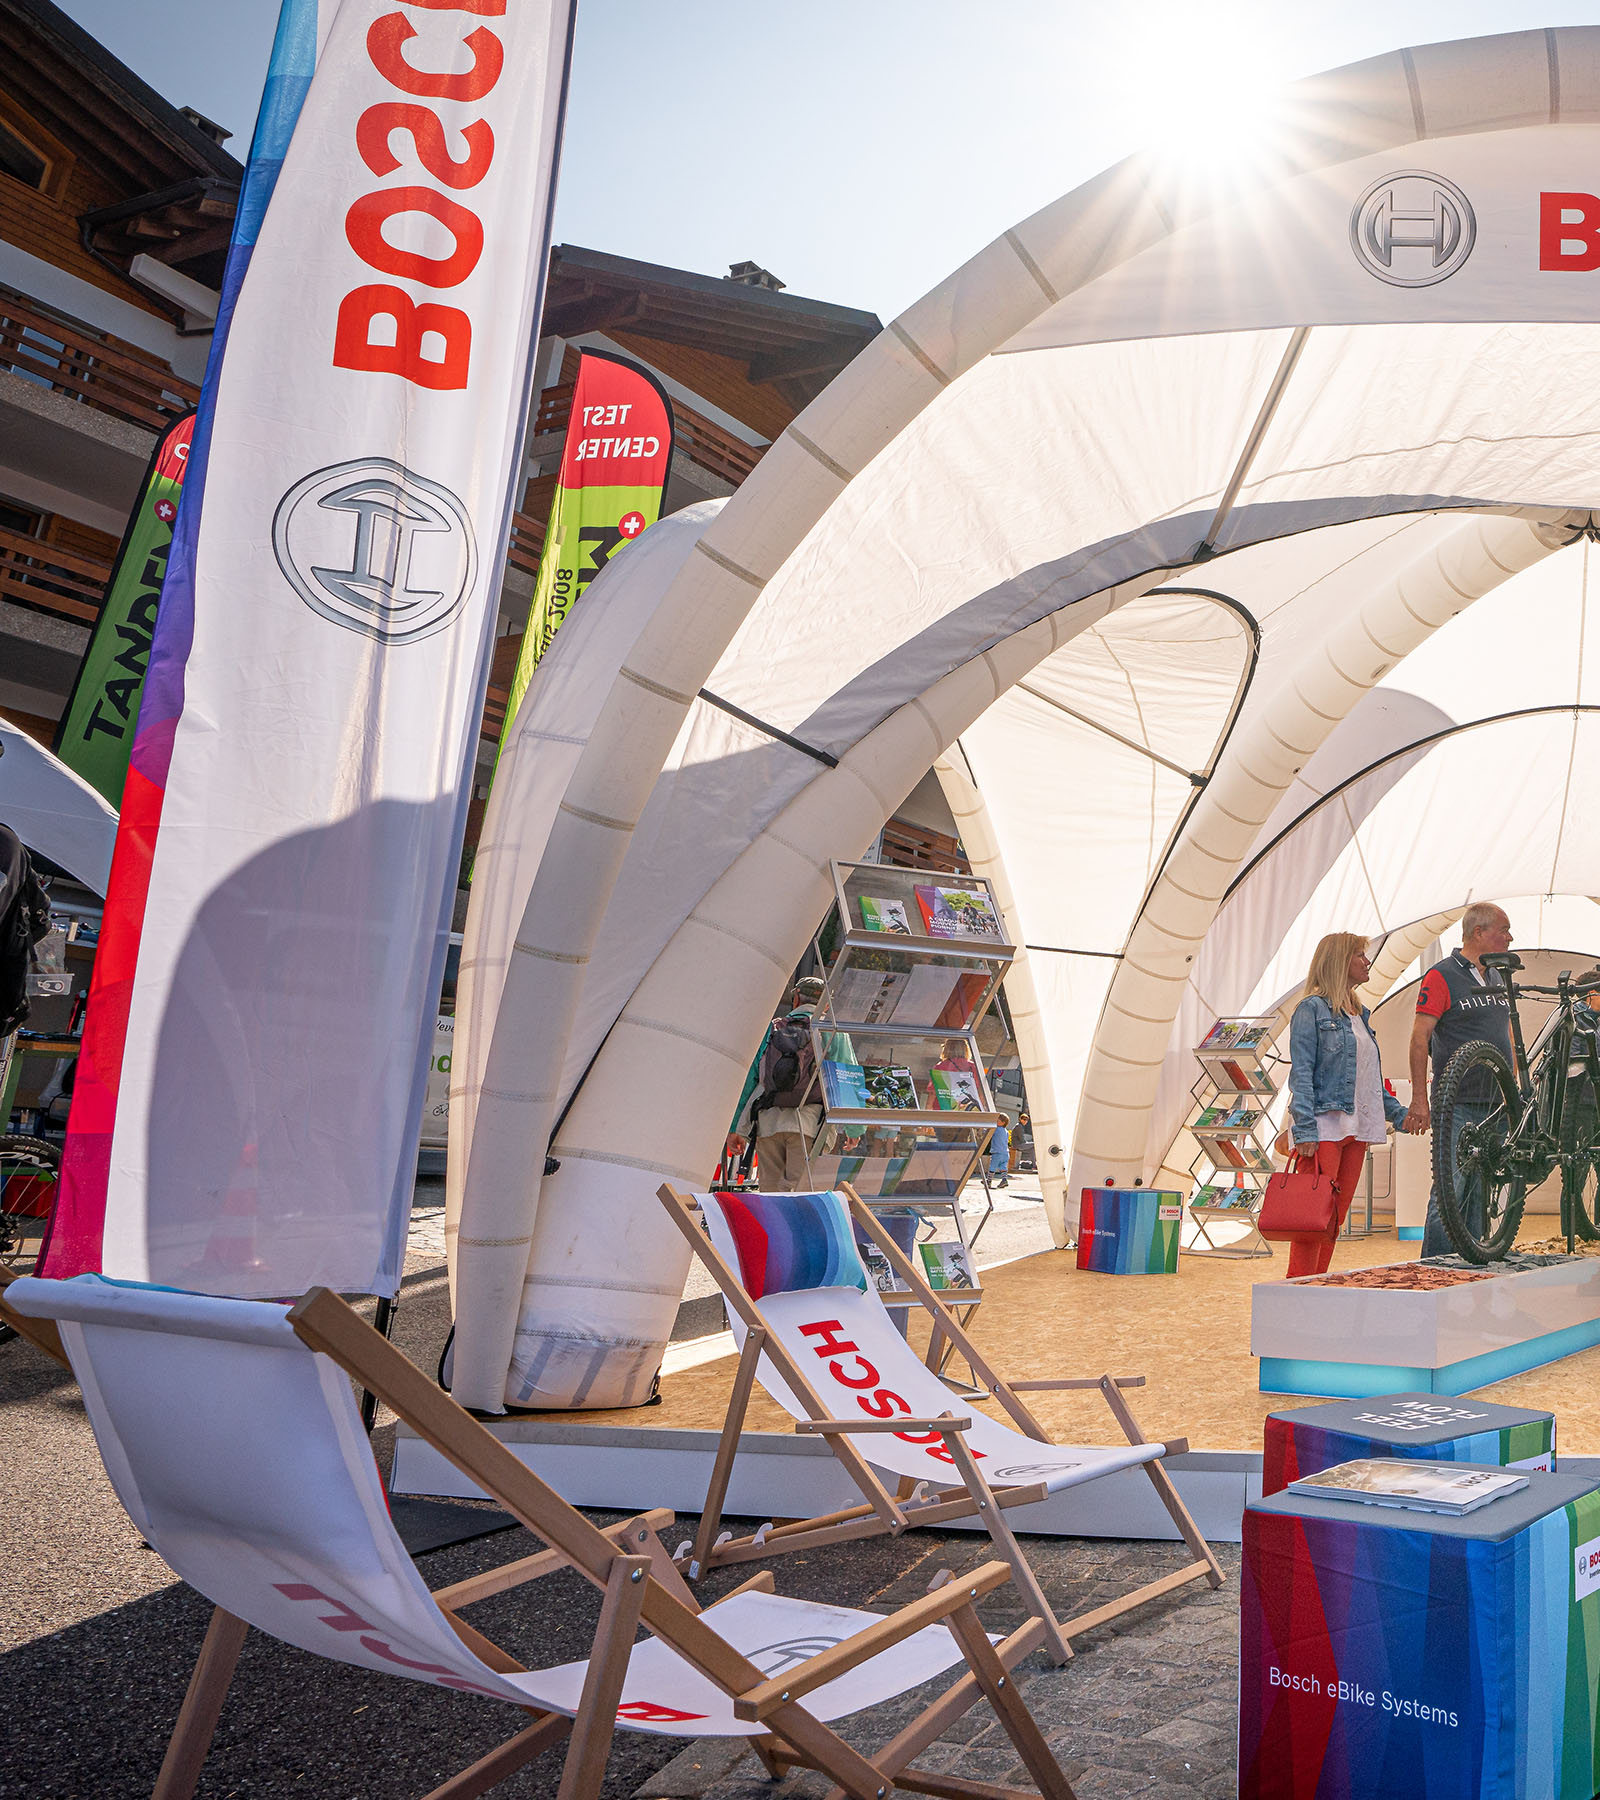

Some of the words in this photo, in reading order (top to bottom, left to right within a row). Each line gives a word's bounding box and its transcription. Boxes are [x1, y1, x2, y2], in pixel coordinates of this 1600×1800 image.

[1459, 995, 1510, 1011] HILFIG
[1388, 1410, 1456, 1425] THE
[1392, 1401, 1489, 1420] FLOW
[1351, 1412, 1431, 1431] FEEL
[1269, 1667, 1320, 1695] Bosch
[1327, 1680, 1375, 1706] eBike
[1381, 1690, 1459, 1728] Systems
